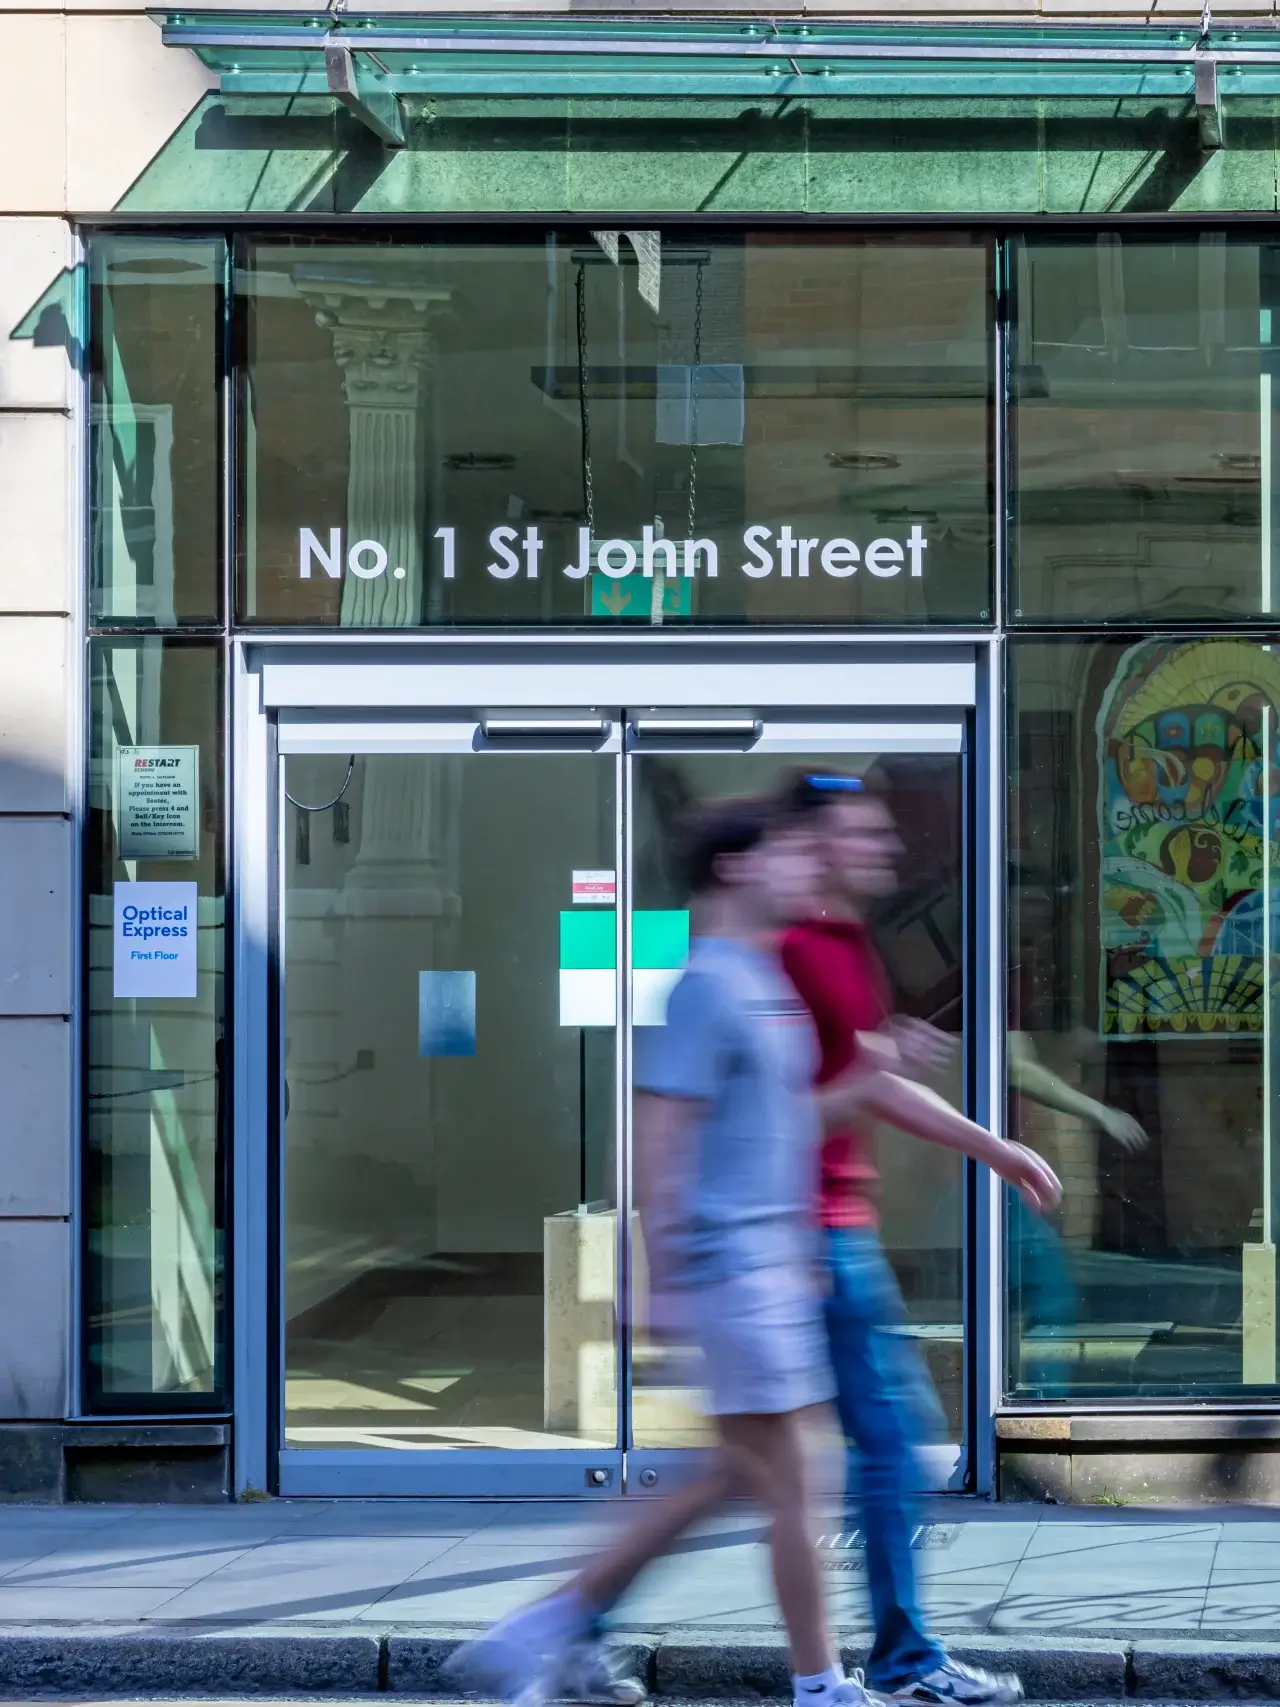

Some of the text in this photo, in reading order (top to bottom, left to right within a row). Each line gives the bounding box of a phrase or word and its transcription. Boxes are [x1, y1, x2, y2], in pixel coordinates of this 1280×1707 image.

[299, 524, 928, 579] No. 1 St John Street
[134, 758, 181, 768] RESTART
[122, 905, 188, 924] Optical
[122, 921, 188, 941] Express
[131, 950, 179, 960] First Floor
